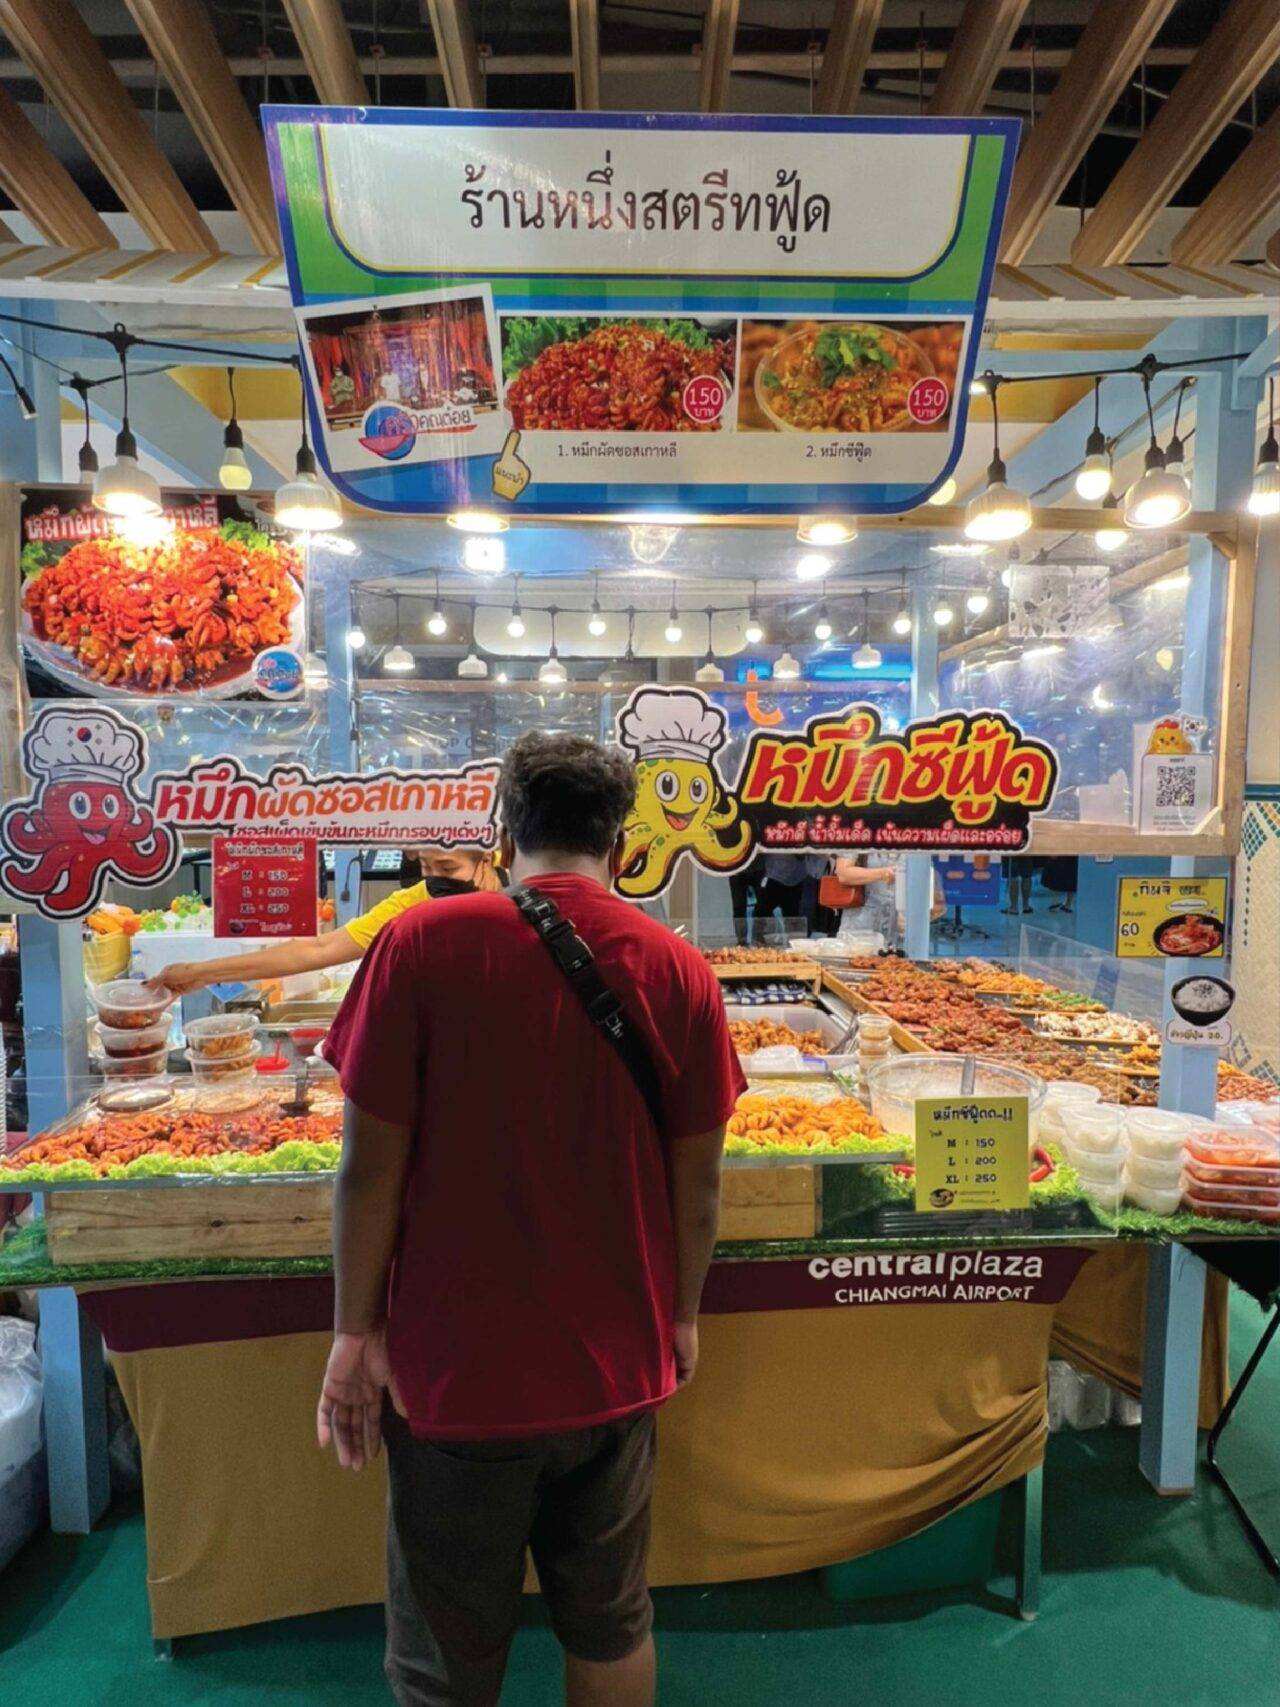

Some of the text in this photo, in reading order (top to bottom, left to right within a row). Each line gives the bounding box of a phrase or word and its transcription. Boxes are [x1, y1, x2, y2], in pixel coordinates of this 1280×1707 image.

[460, 150, 831, 253] ร้านหนึ่งสตรีทฟู้ด
[687, 387, 722, 407] 150
[912, 387, 944, 407] 150
[693, 407, 716, 418] บาท
[916, 408, 937, 418] บาท
[557, 444, 569, 457] 1.
[806, 444, 817, 458] 2.
[745, 714, 1050, 824] หมึกซีฟู้ด
[155, 767, 497, 822] หมึกผัดซอสเกาหลี
[268, 870, 288, 881] 150
[1121, 922, 1139, 937] 60
[947, 1139, 957, 1148] M
[976, 1138, 995, 1148] 150
[949, 1157, 956, 1167] L
[975, 1157, 997, 1166] 200
[945, 1174, 959, 1184] XL
[975, 1174, 997, 1183] 250
[834, 1284, 1035, 1303] CHIANGMAI AIRPORT
